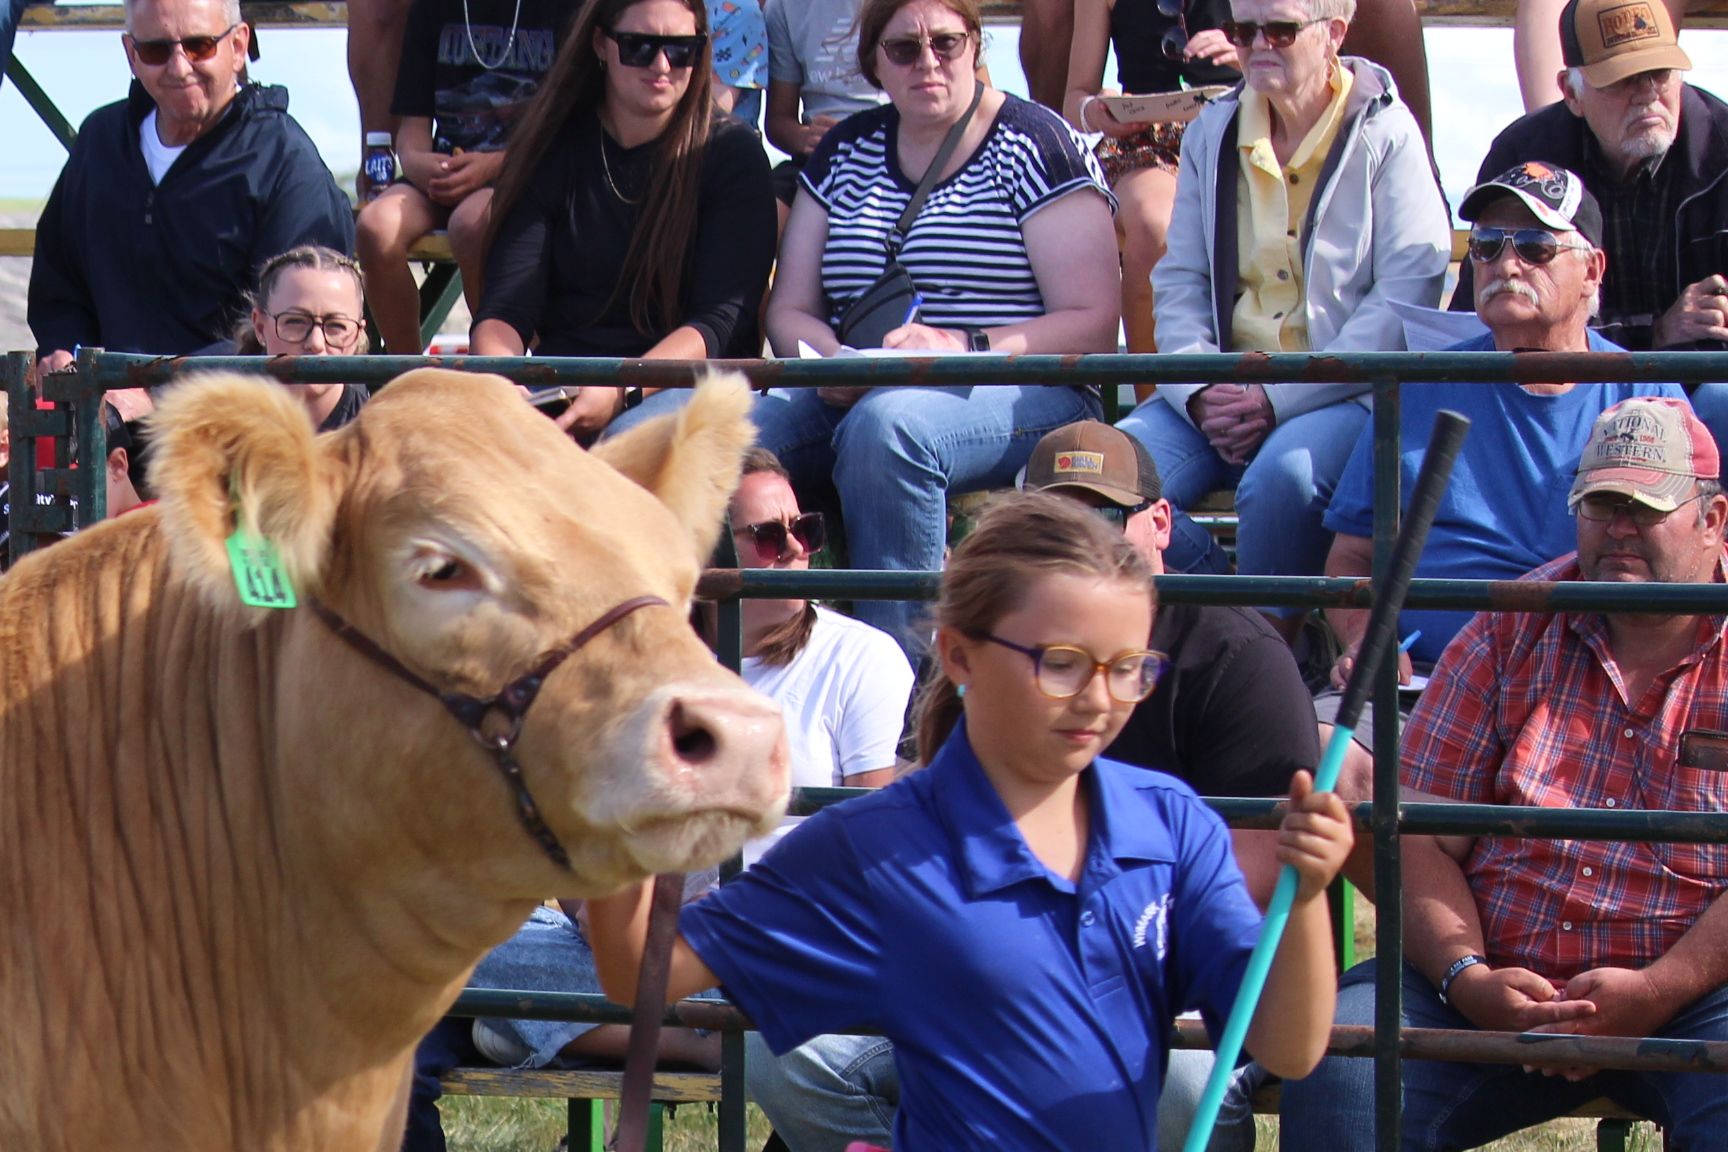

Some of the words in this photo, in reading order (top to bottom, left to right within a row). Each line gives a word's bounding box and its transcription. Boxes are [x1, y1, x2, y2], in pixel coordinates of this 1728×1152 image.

[1604, 6, 1652, 36] RODEO
[1603, 414, 1665, 441] NATIONAL
[1595, 443, 1665, 461] WESTERN
[245, 566, 287, 604] 414
